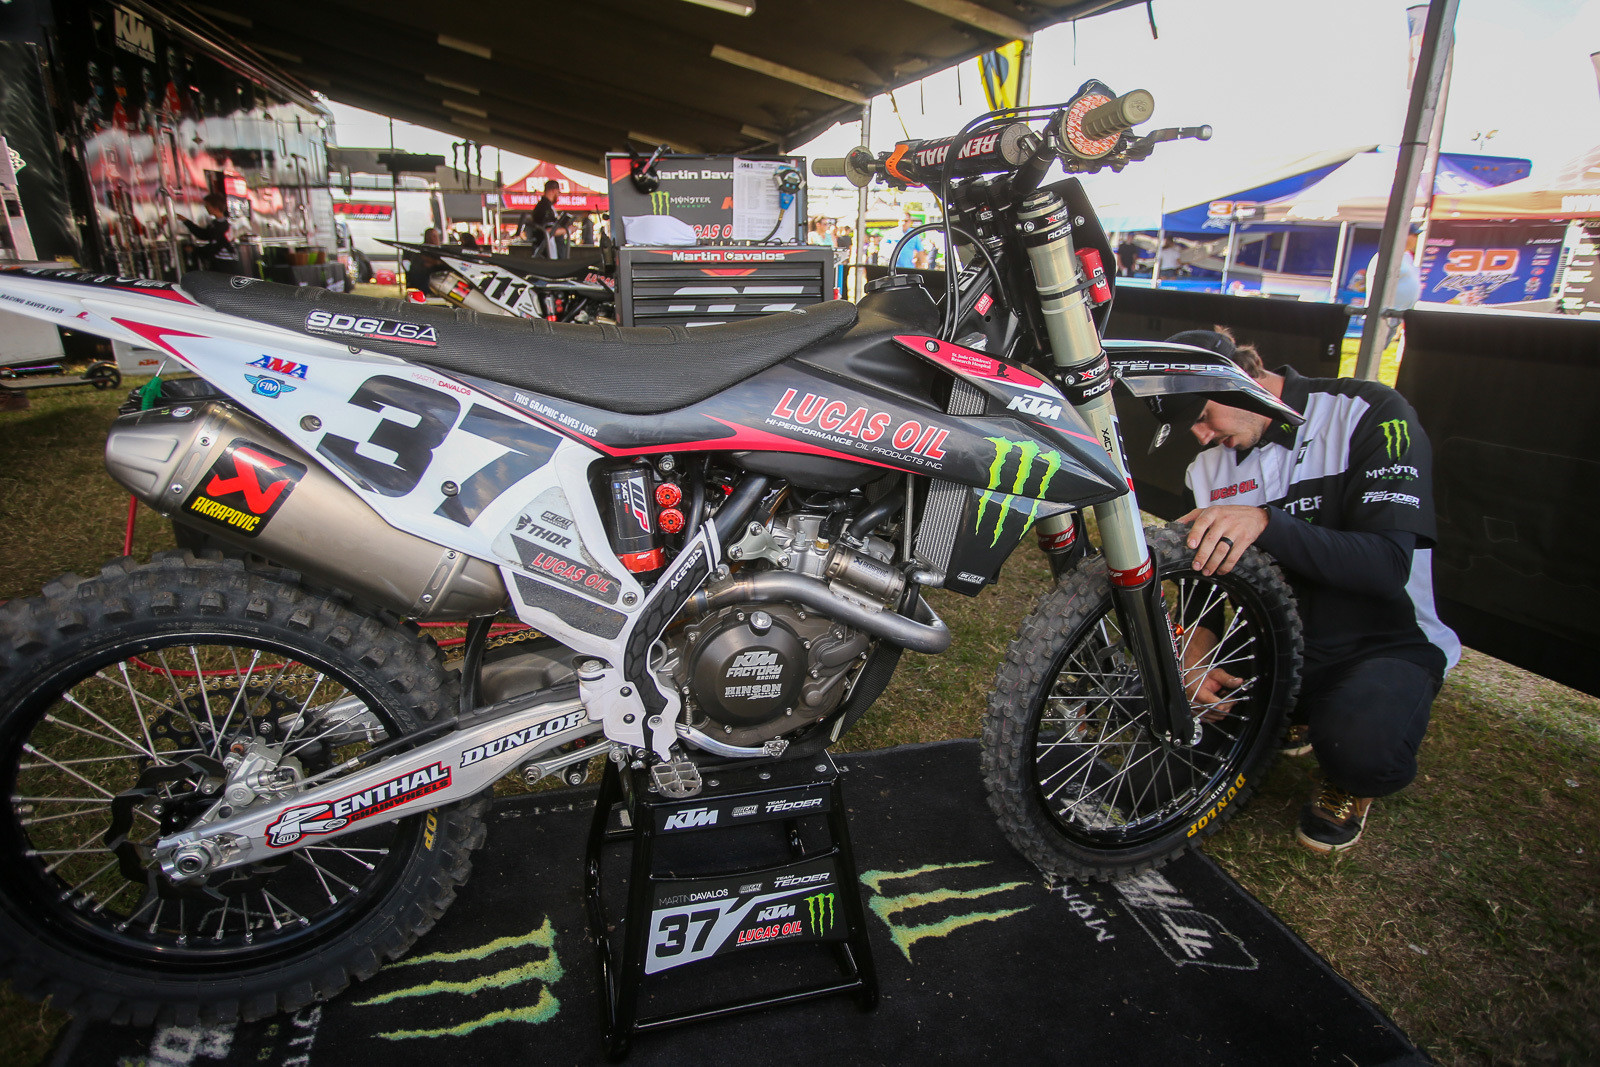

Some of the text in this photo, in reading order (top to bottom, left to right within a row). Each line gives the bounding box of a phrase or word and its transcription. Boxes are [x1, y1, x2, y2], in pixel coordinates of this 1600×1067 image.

[113, 4, 155, 54] KTM
[917, 131, 1000, 168] RENHAL
[701, 169, 734, 181] Dava
[692, 224, 720, 240] CAS
[671, 251, 721, 262] Martin
[1442, 247, 1521, 277] 3D
[244, 354, 309, 381] AMA
[259, 381, 278, 392] FIM
[1083, 378, 1111, 398] ROCS
[512, 391, 599, 438] THIS GRAPHIC SAVES LIVES
[1007, 393, 1062, 421] KTM
[771, 387, 952, 460] LUCAS OIL
[315, 374, 564, 528] 37
[854, 441, 871, 452] OIL
[871, 446, 924, 465] PRODUCTS
[620, 482, 630, 504] XACT
[1209, 478, 1259, 502] LUCAS OIL
[1361, 492, 1420, 505] TEDDER
[525, 523, 572, 549] THOR
[531, 552, 587, 582] LUCAS
[584, 573, 612, 593] OIL
[725, 664, 784, 678] FACTORY
[731, 650, 779, 668] KTM
[724, 683, 783, 696] HINSON
[459, 709, 587, 769] DUNLOP
[265, 763, 450, 848] RENTHAL
[350, 779, 449, 822] CHAINWHEELS
[765, 797, 823, 813] TEDDER
[1186, 772, 1247, 838] DUNLOP
[663, 806, 719, 831] KTM
[773, 872, 830, 888] TEDDER
[756, 903, 796, 922] KTM
[654, 907, 721, 959] 37
[736, 920, 803, 944] LUCAS OIL
